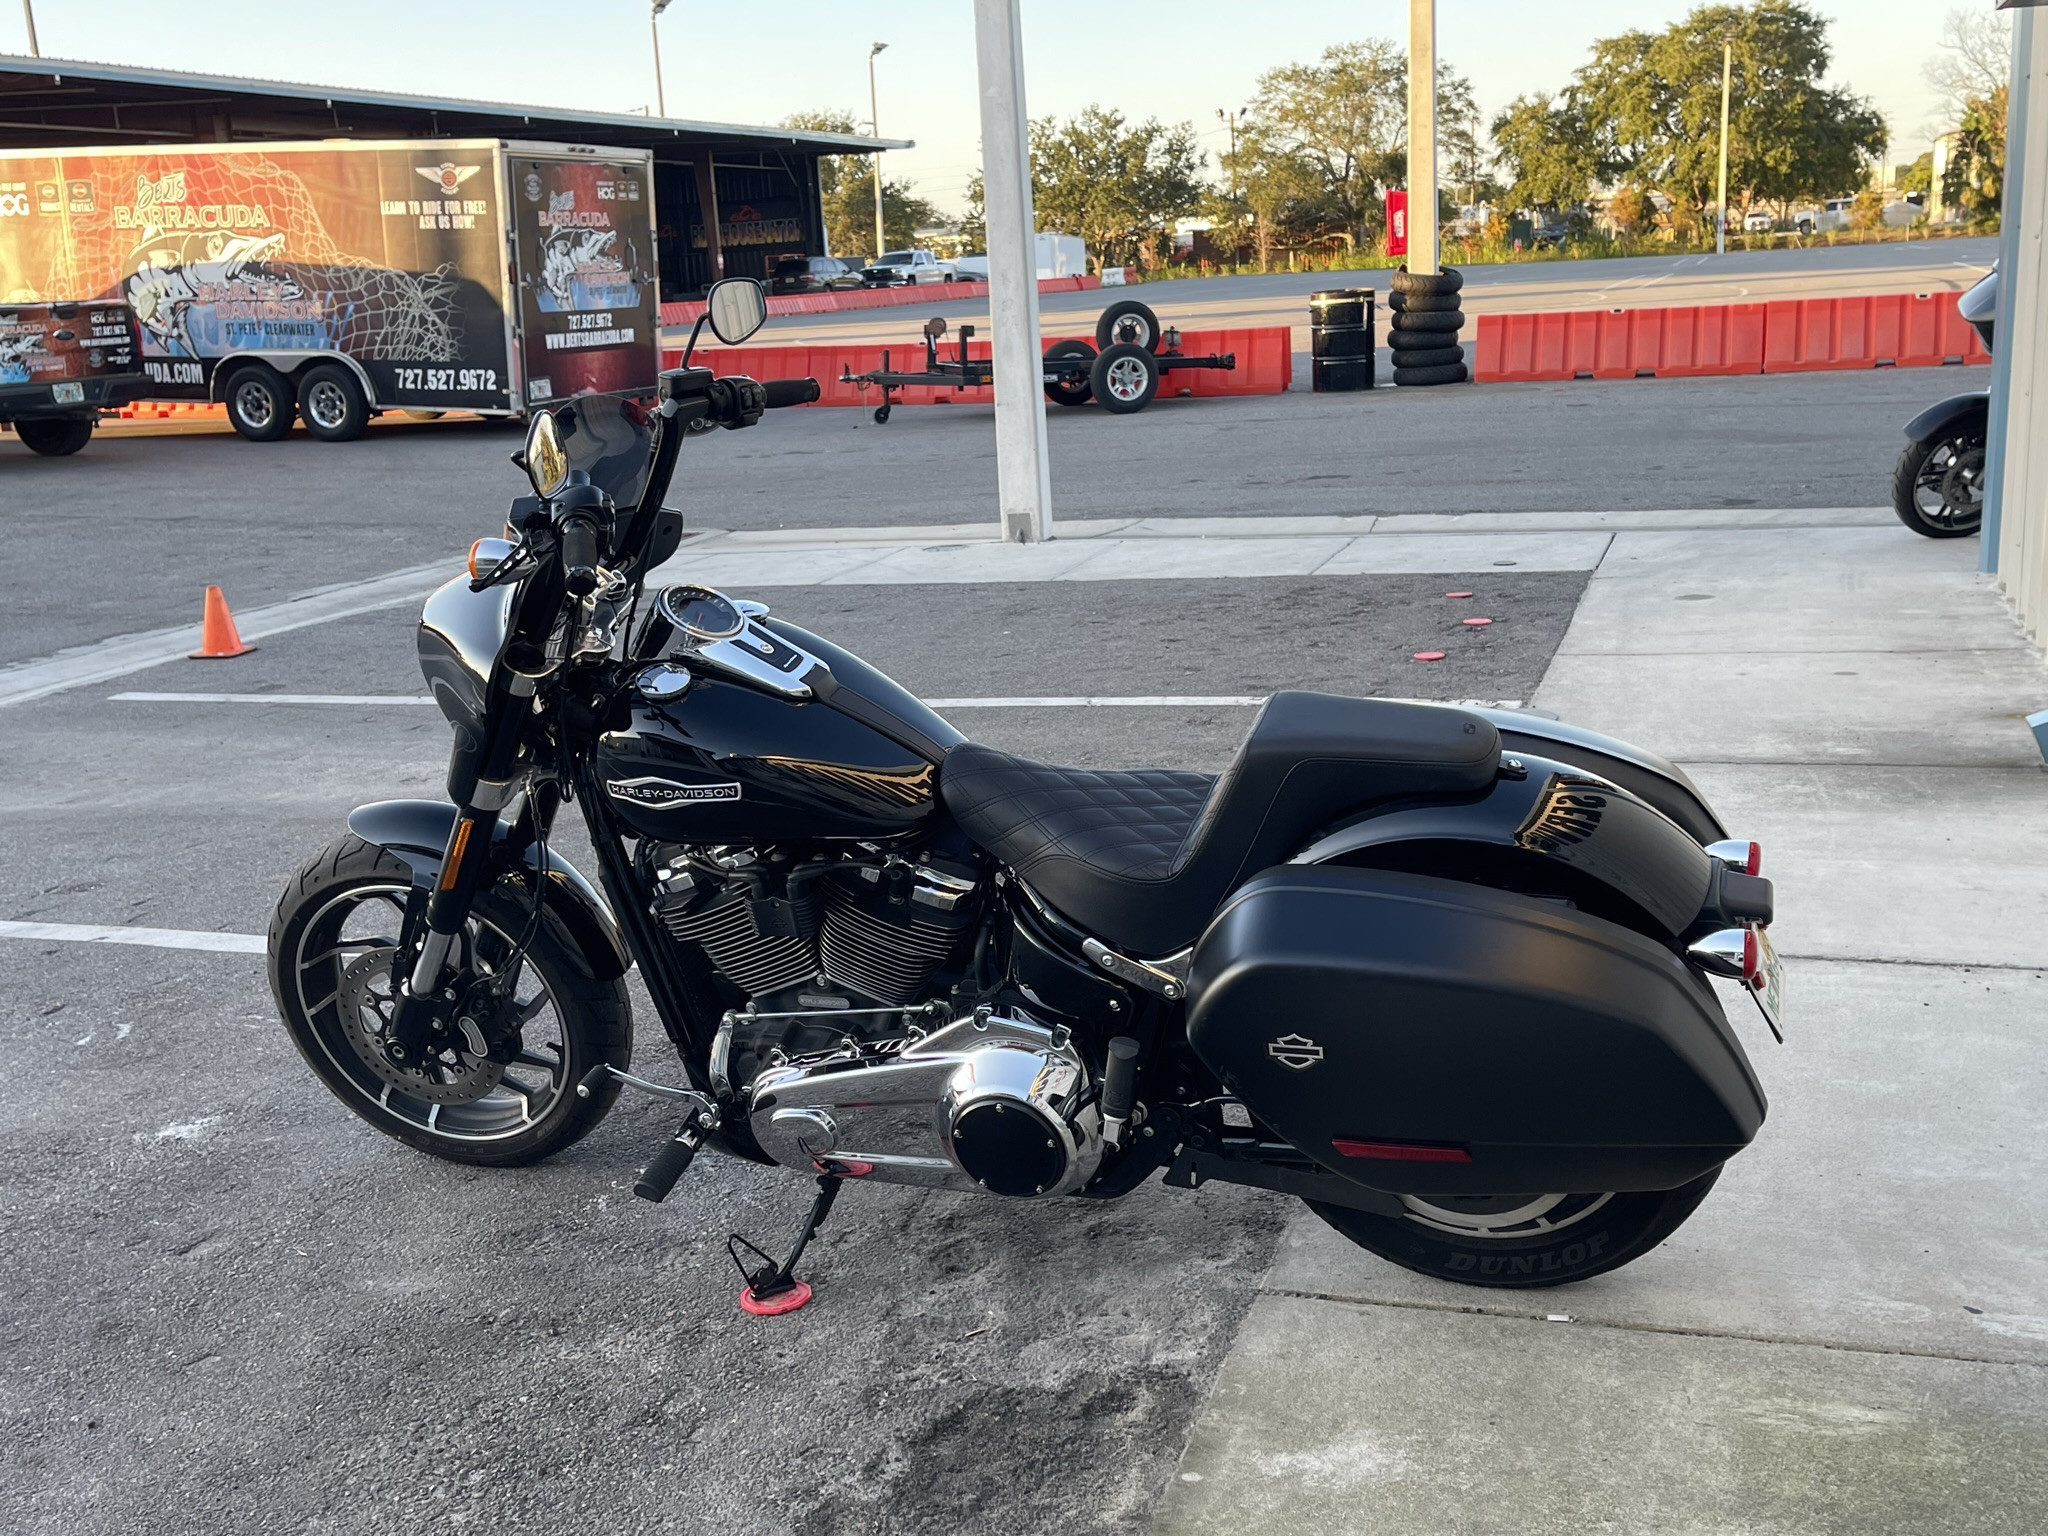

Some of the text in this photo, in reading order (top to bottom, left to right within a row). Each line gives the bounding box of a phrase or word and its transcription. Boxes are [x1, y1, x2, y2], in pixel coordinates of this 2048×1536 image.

[0, 193, 30, 217] OG
[408, 200, 421, 215] TO
[422, 200, 443, 215] RIDE
[444, 200, 461, 215] FOR
[463, 200, 487, 215] FREE!
[113, 205, 271, 229] BARRACUDA
[438, 215, 451, 230] US
[538, 210, 611, 227] BARRACUDA
[198, 282, 285, 301] HARLEY
[215, 300, 323, 321] DAVIDSON
[239, 322, 257, 336] PETE
[264, 322, 316, 336] CLEARWATER
[394, 367, 498, 391] 727.527.9672
[611, 784, 736, 799] HARLEY-DAVIDSON
[1444, 1230, 1611, 1276] DUNLOP
